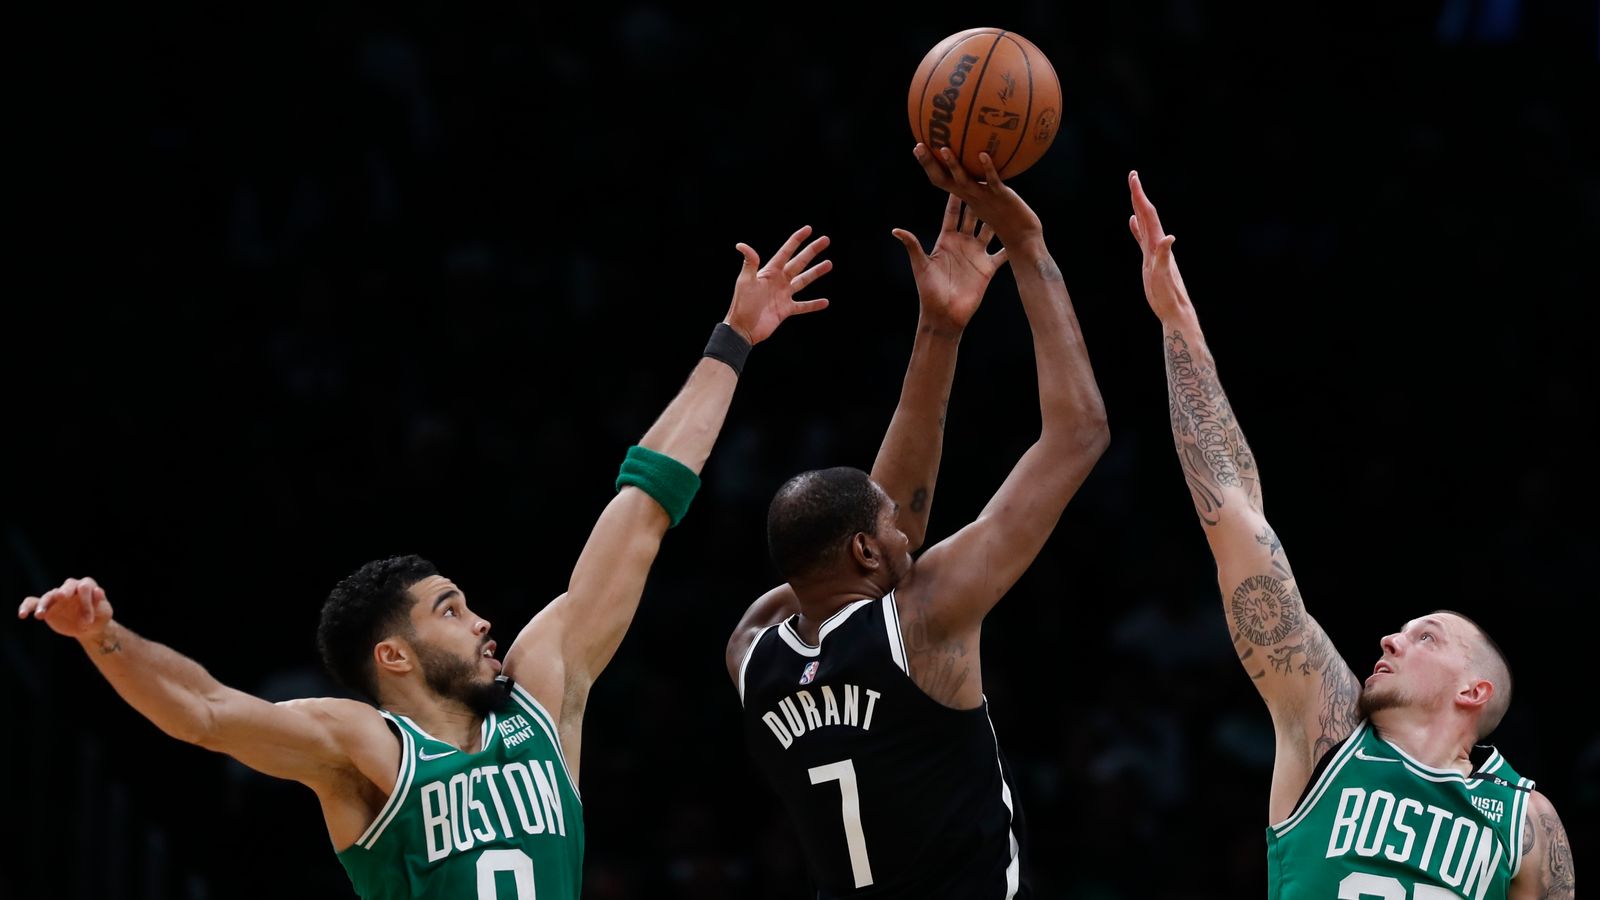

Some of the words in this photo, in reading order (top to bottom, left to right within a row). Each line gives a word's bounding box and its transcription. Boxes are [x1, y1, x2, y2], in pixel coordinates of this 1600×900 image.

[929, 54, 980, 149] Wilson
[503, 725, 535, 749] PRINT
[762, 684, 880, 750] DURANT
[421, 759, 566, 863] BOSTON
[1471, 795, 1504, 814] VISTA
[1472, 805, 1504, 823] INT
[1494, 777, 1508, 787] 24
[808, 758, 873, 888] 7
[1325, 787, 1503, 900] BOSTON
